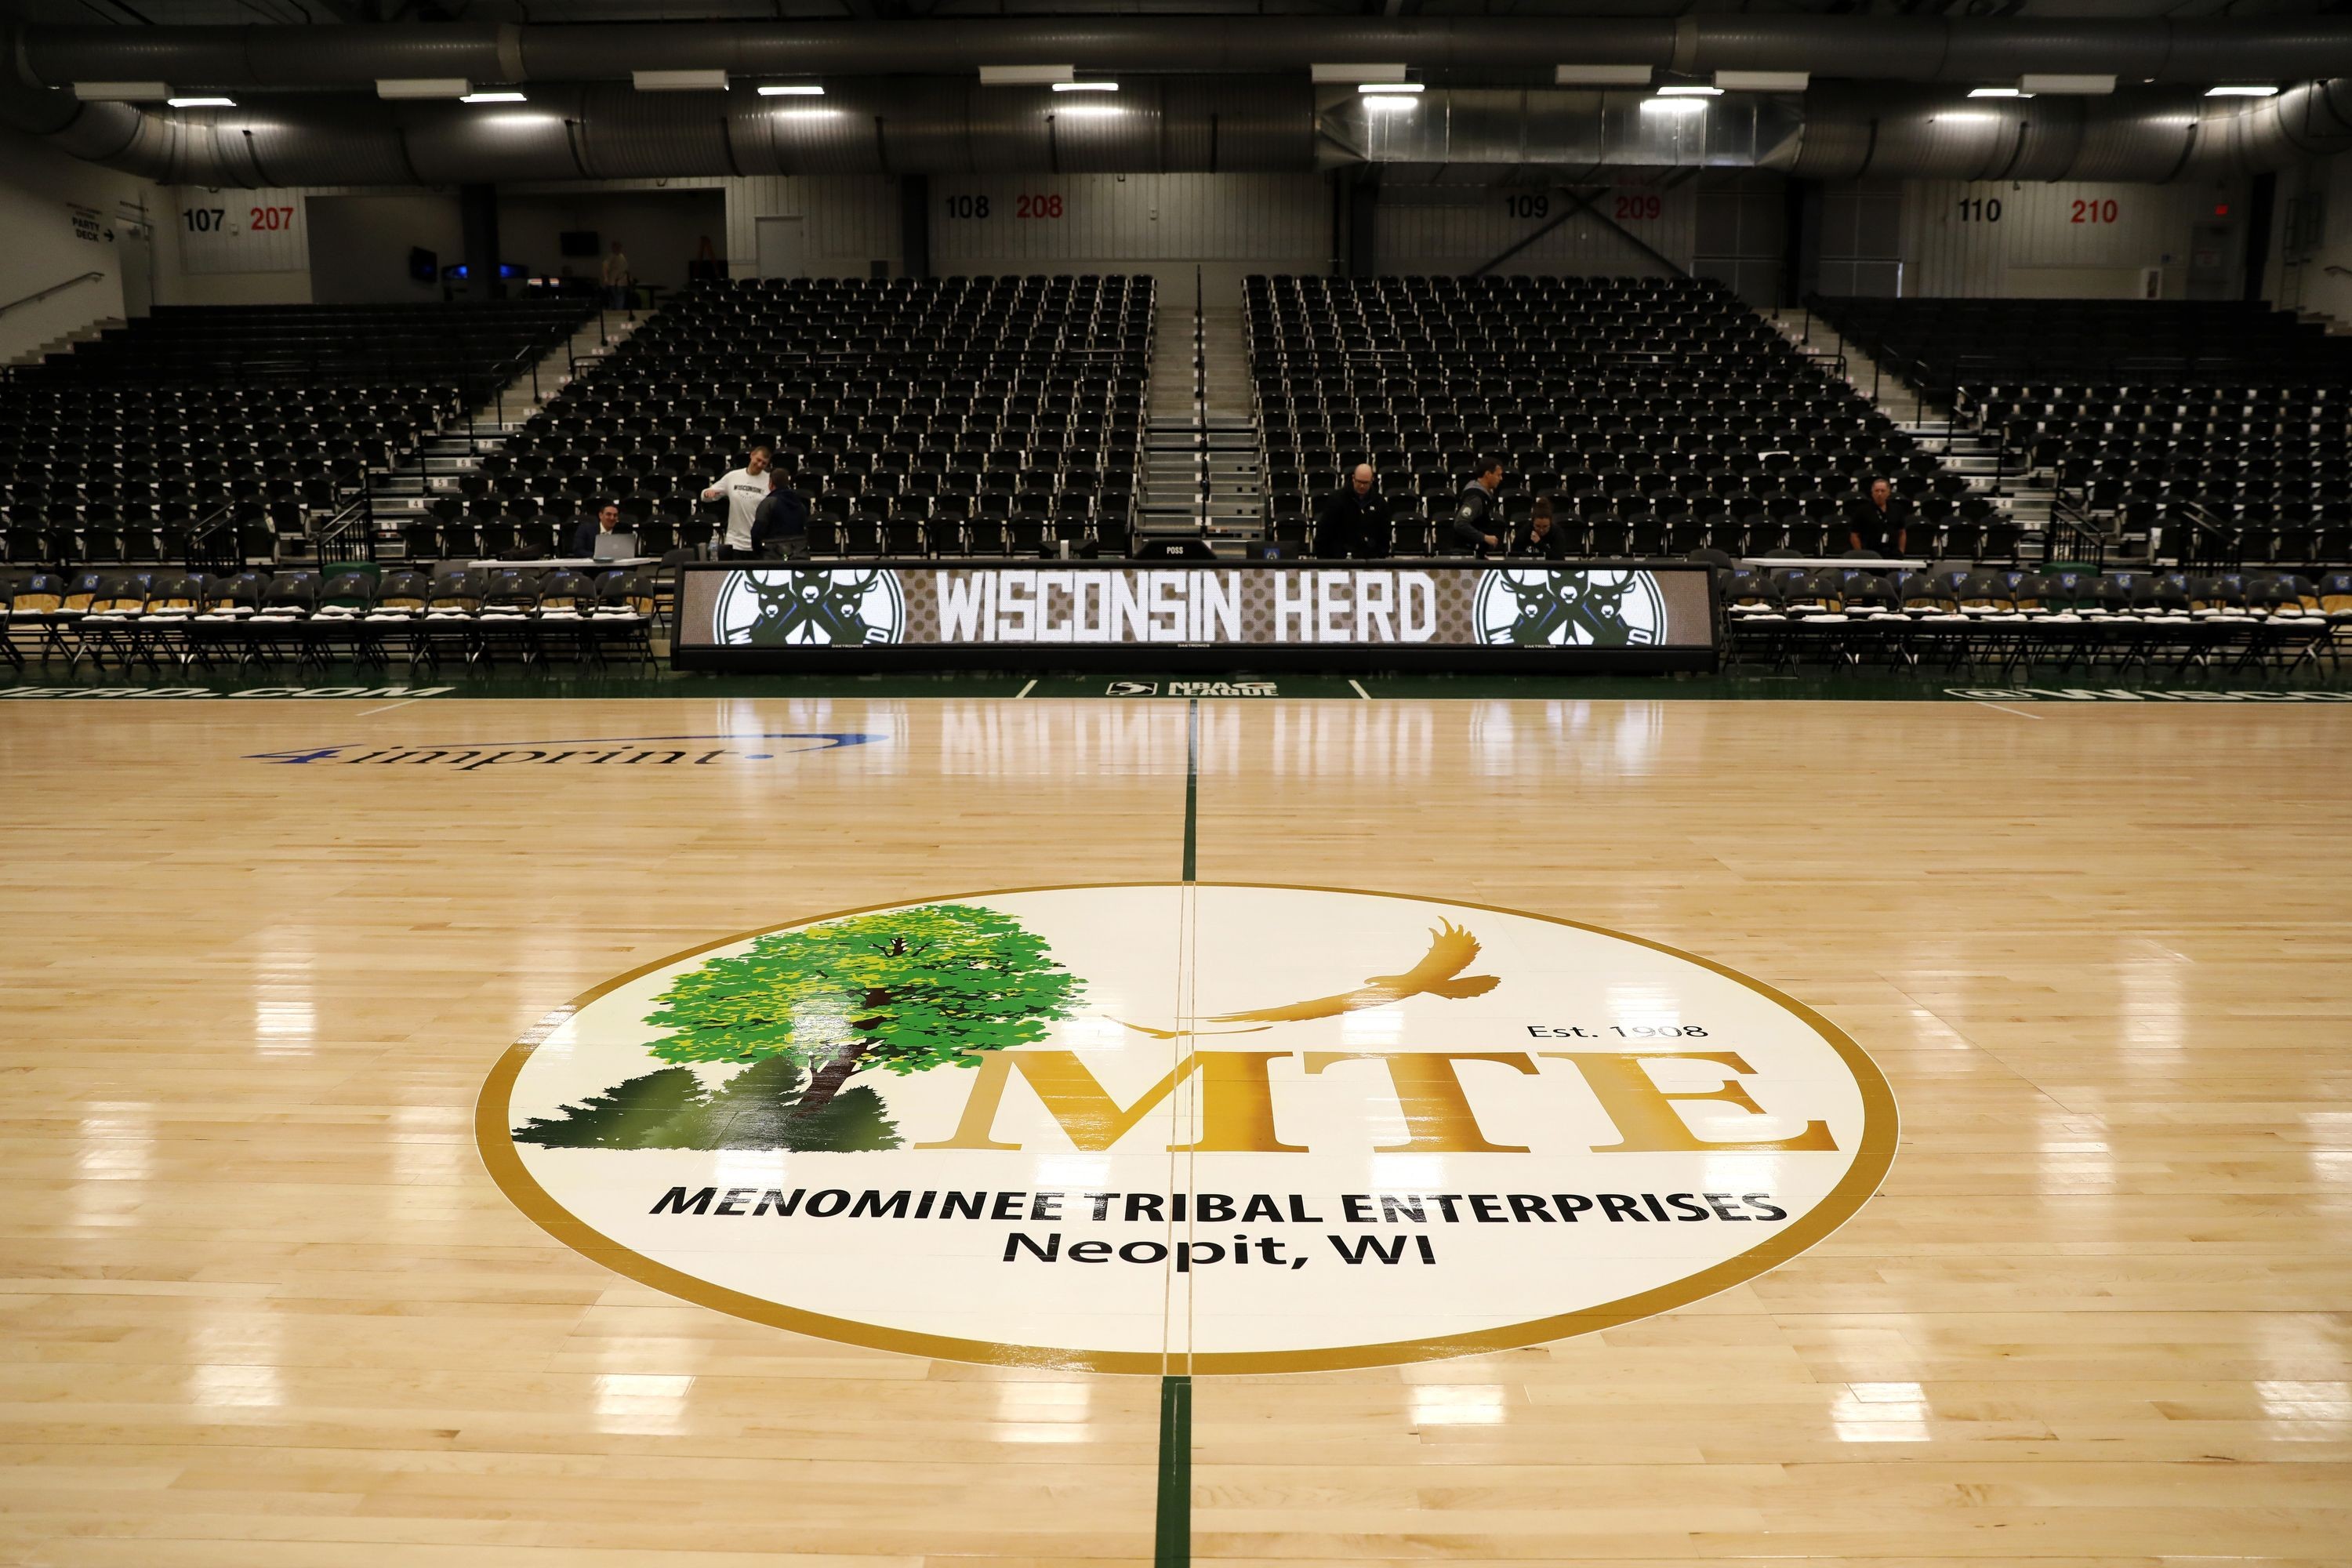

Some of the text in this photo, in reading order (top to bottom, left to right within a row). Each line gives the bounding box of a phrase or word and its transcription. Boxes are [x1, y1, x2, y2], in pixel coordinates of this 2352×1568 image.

[250, 207, 294, 230] 207
[946, 194, 989, 219] 108
[1016, 194, 1063, 219] 208
[1505, 194, 1548, 219] 109
[1615, 195, 1661, 220] 209
[1958, 198, 2002, 222] 110
[2070, 199, 2118, 223] 210
[72, 217, 100, 231] PARTY
[183, 209, 225, 232] 107
[76, 229, 99, 241] DECK
[1167, 546, 1184, 555] POSS
[936, 571, 1436, 641] WISCONSIN HERD
[1167, 681, 1231, 690] NBA
[1167, 688, 1279, 697] LEAGUE
[1943, 688, 2352, 701] @WISCO
[1526, 1025, 1709, 1038] Est. 1908
[912, 1050, 1840, 1153] MTE
[648, 1186, 1788, 1222] MENOMINEE TRIBAL ENTERPRISES
[1003, 1232, 1436, 1272] Neopit, WI
